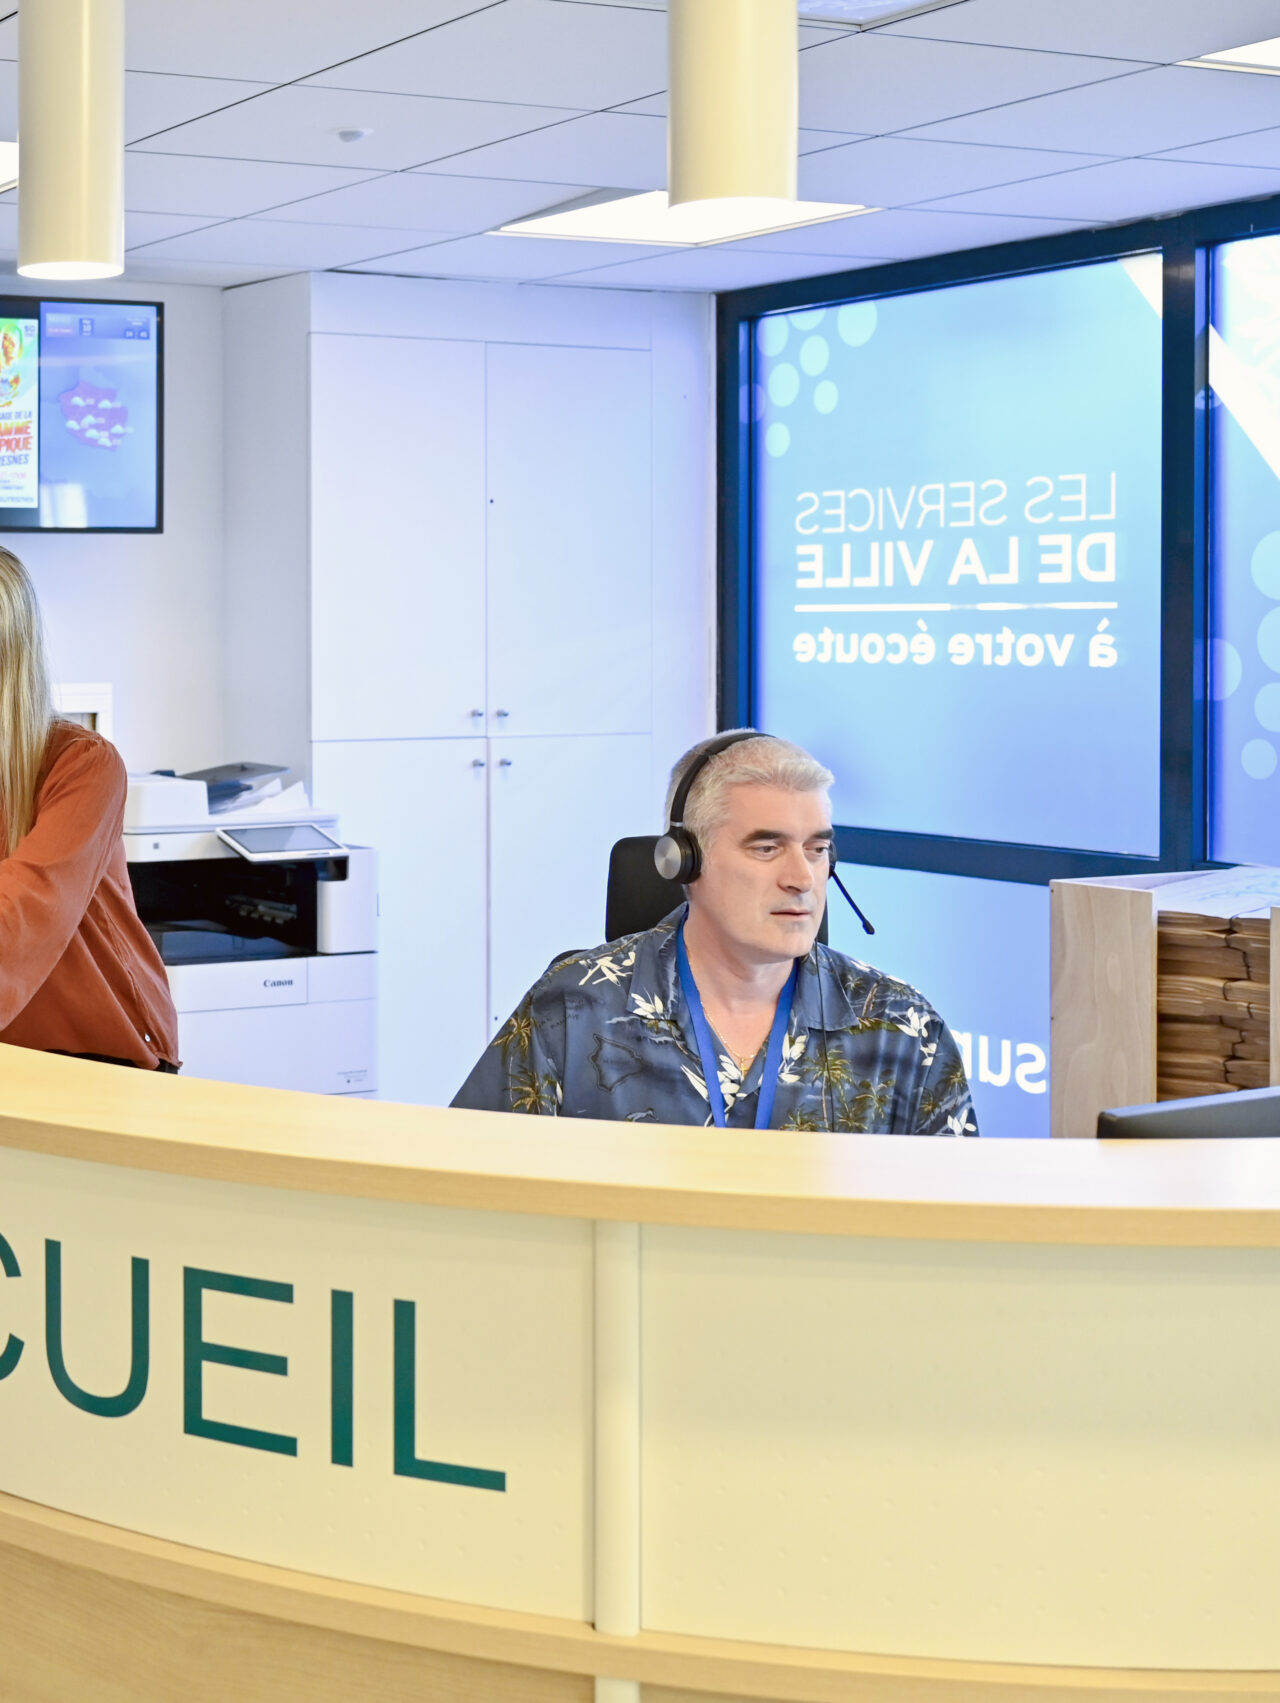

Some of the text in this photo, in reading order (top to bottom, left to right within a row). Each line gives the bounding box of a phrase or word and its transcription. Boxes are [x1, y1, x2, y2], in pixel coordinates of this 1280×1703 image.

[14, 410, 23, 419] DE
[23, 410, 32, 419] LA
[263, 978, 293, 988] Canon
